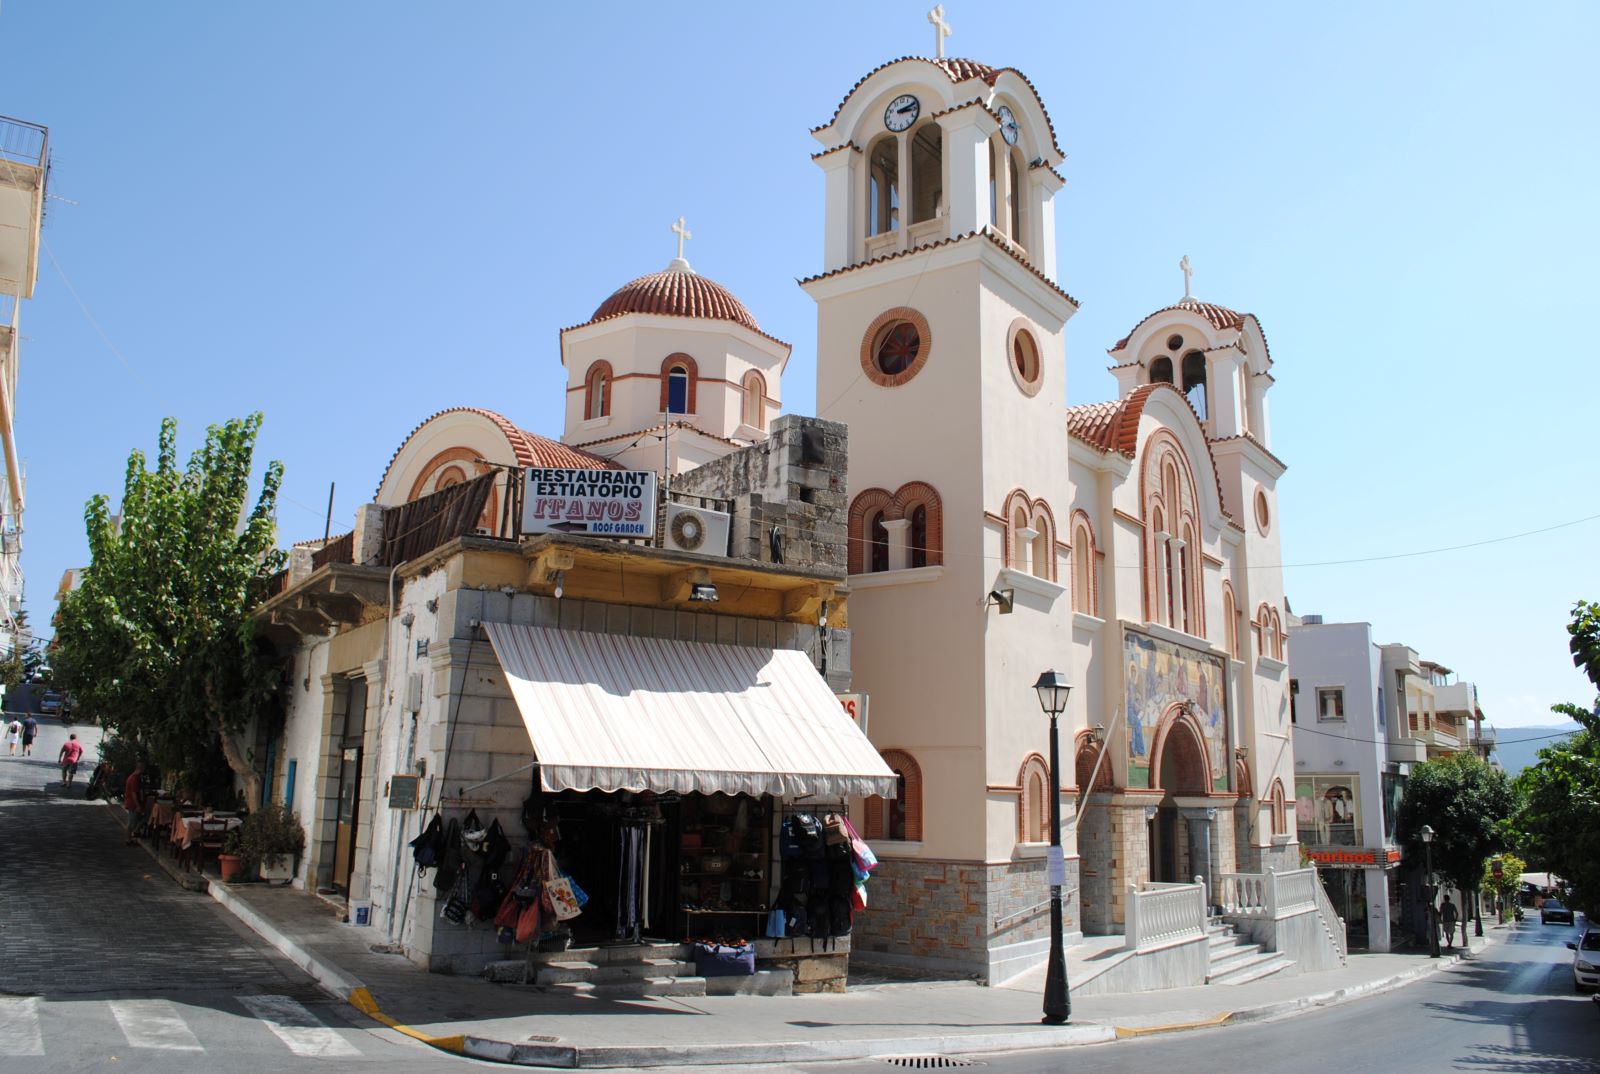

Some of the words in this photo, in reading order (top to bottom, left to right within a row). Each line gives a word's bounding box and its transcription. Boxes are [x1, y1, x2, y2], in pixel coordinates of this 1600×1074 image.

[531, 469, 648, 485] RESTAURANT
[537, 482, 642, 498] ΕΣΤΙΑΤΟΡΙΟ
[533, 498, 642, 521] ITANOS
[593, 523, 614, 533] ROOF
[615, 523, 644, 533] GARDEN
